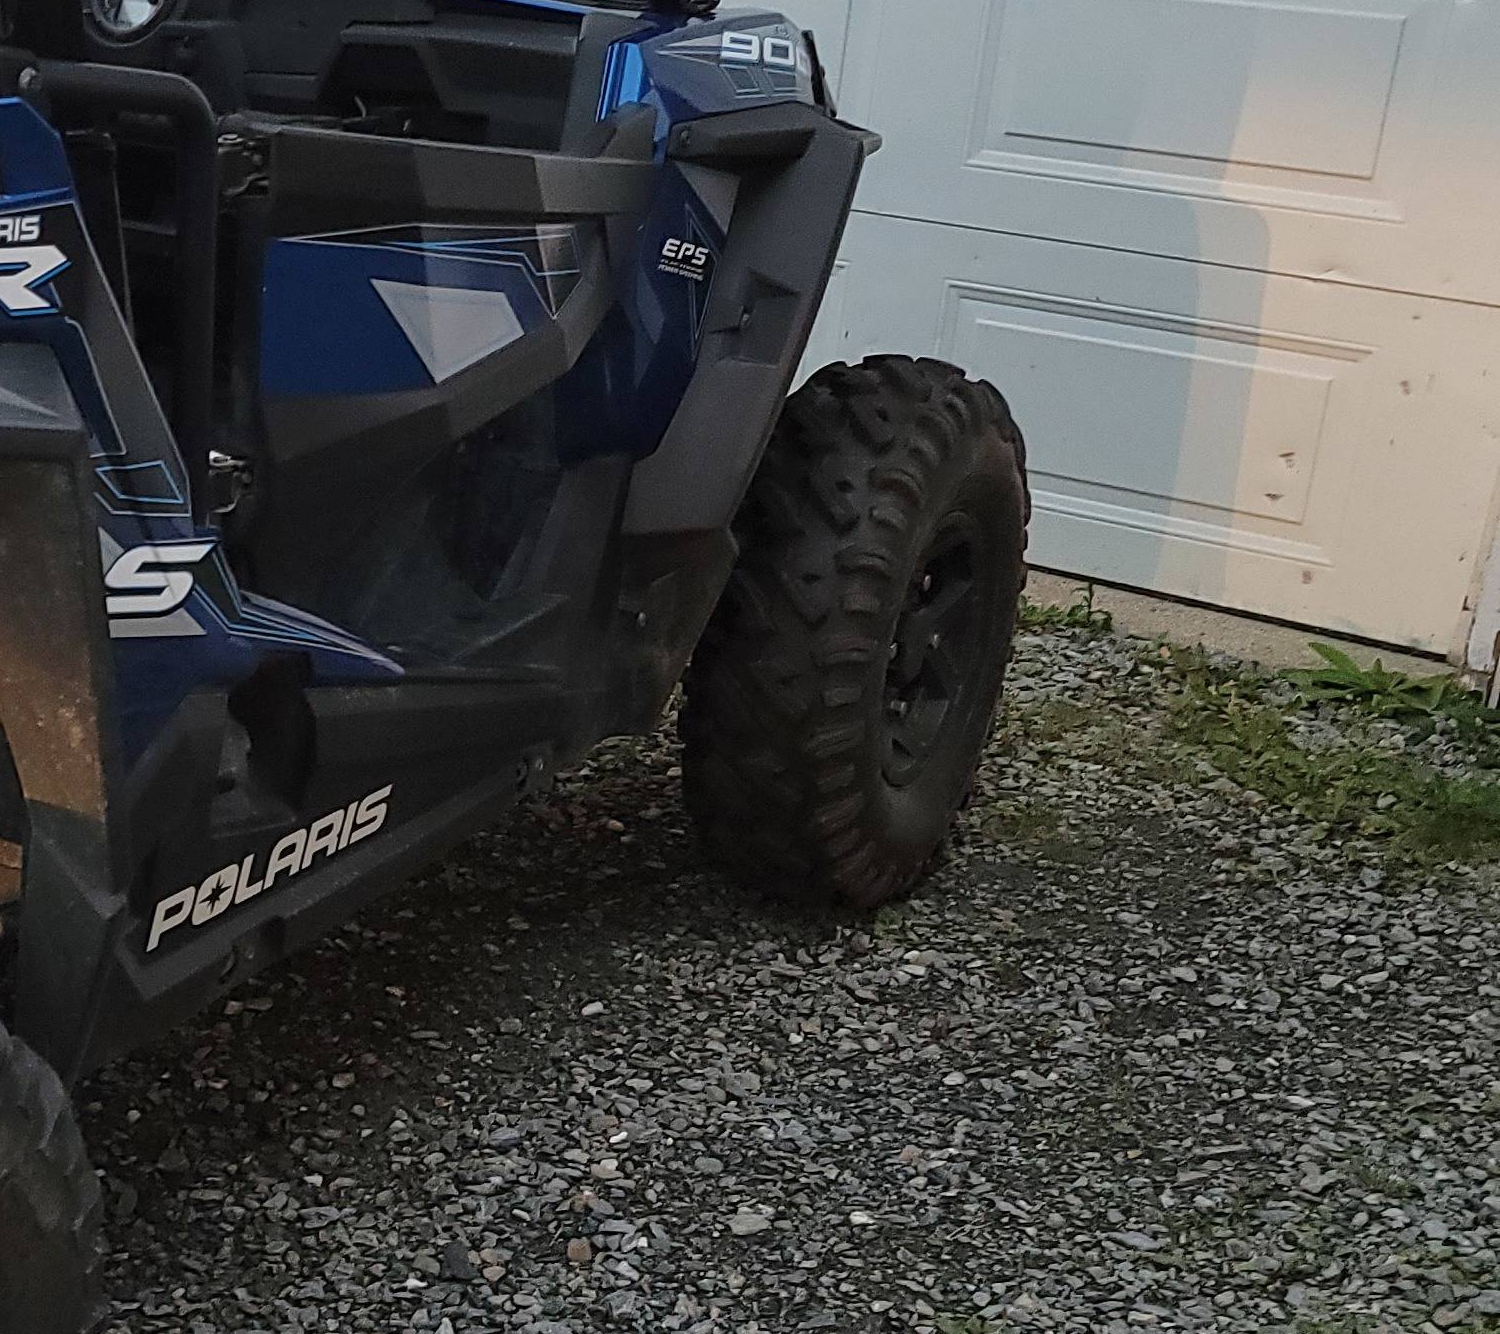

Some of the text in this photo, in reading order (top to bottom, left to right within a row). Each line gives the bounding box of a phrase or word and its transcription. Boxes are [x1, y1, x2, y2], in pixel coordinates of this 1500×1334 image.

[662, 238, 709, 266] EPS
[104, 543, 217, 615] S
[146, 783, 393, 953] POLARIS
